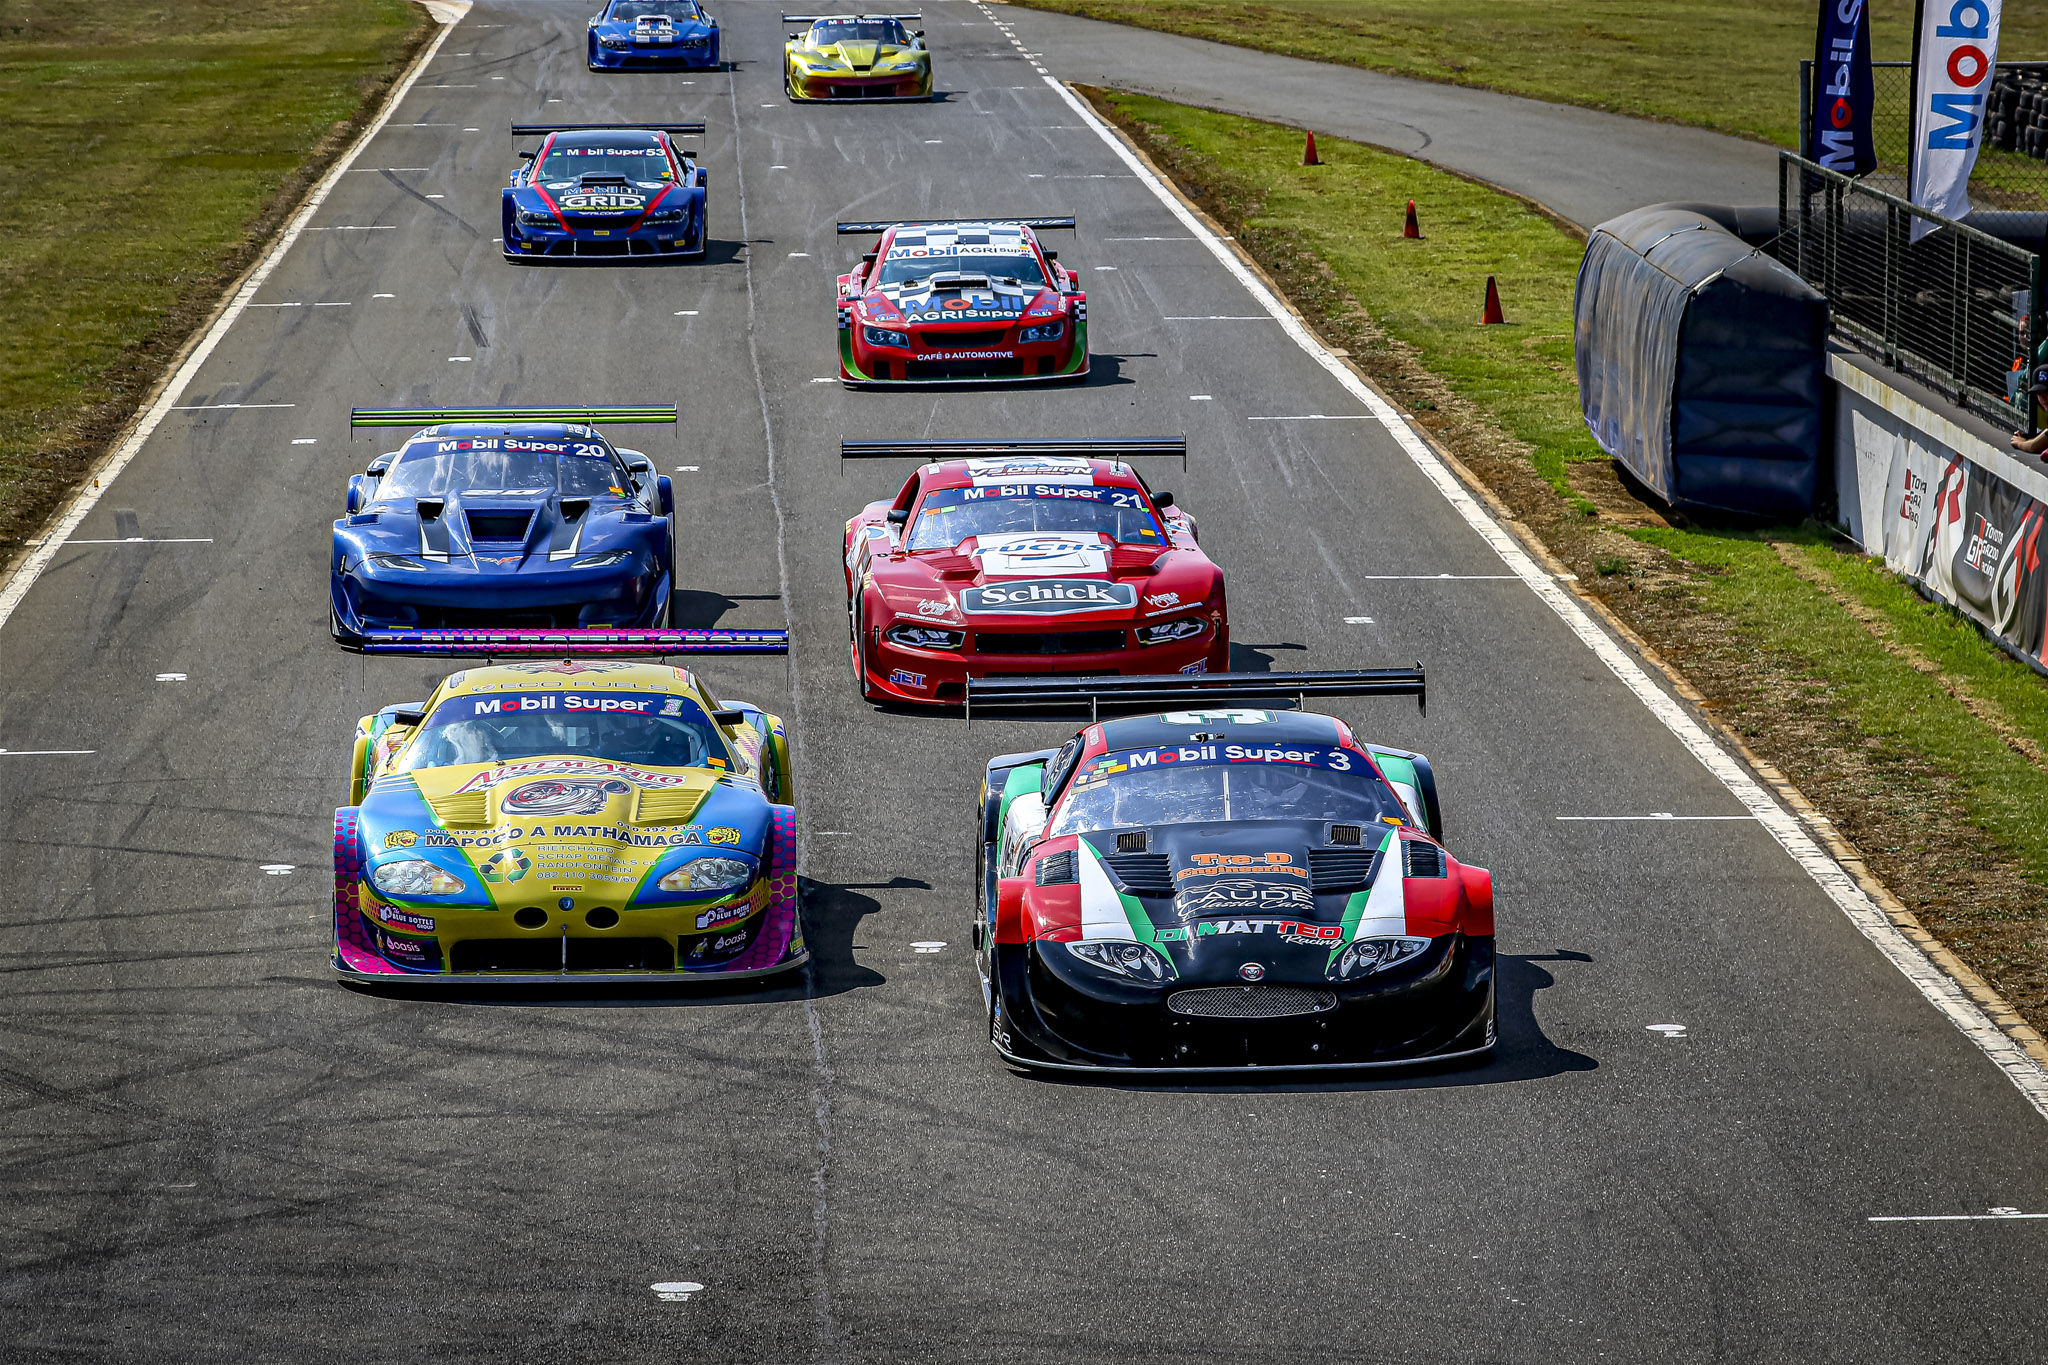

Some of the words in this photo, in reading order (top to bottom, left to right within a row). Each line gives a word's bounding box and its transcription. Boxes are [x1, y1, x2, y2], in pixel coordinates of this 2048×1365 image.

[1821, 37, 1855, 171] Mobil
[566, 148, 604, 156] Mobil
[606, 148, 645, 158] Super
[645, 148, 665, 157] 53
[564, 186, 618, 195] Mobil
[565, 196, 641, 207] GRID
[889, 247, 958, 258] Mobil
[905, 296, 1021, 313] Mobil
[907, 311, 963, 323] AGRI
[965, 309, 1022, 319] Super
[917, 352, 943, 361] CAFÉ
[952, 351, 1014, 359] AUTOMOTIVE
[438, 439, 498, 453] Mobil
[504, 439, 567, 452] Super
[574, 443, 606, 458] 20
[964, 485, 1029, 501] Mobil
[1035, 484, 1103, 499] Super
[1111, 493, 1143, 509] 21
[1985, 522, 2004, 545] TOYOTA
[969, 543, 1113, 559] FUCHS
[1982, 540, 1999, 561] GAZOO
[981, 584, 1122, 606] Schick
[500, 681, 562, 689] ECO
[574, 681, 669, 691] FUELS
[474, 695, 556, 715] Mobil
[563, 695, 650, 712] Super
[1129, 746, 1216, 768] Mobil
[1225, 746, 1317, 762] Super
[1328, 752, 1351, 771] 3
[530, 826, 547, 837] A
[553, 825, 702, 846] MATHAMAGA
[537, 846, 614, 854] RIETCHARD
[587, 854, 638, 866] METALS
[1191, 853, 1292, 866] Tre-D
[536, 872, 559, 880] 082
[562, 871, 586, 879] 410
[537, 862, 633, 874] RANDFONTEIN
[1177, 865, 1309, 881] Engineering
[716, 912, 732, 920] BLUE
[733, 903, 750, 915] BOTTLE
[1177, 899, 1257, 922] Classic
[1258, 899, 1315, 911] Cars
[392, 913, 407, 922] BLUE
[408, 917, 434, 926] BOTTLE
[1196, 920, 1343, 939] MATTEO
[724, 929, 747, 947] oasis
[1280, 934, 1345, 950] Racing
[394, 942, 421, 952] oasis
